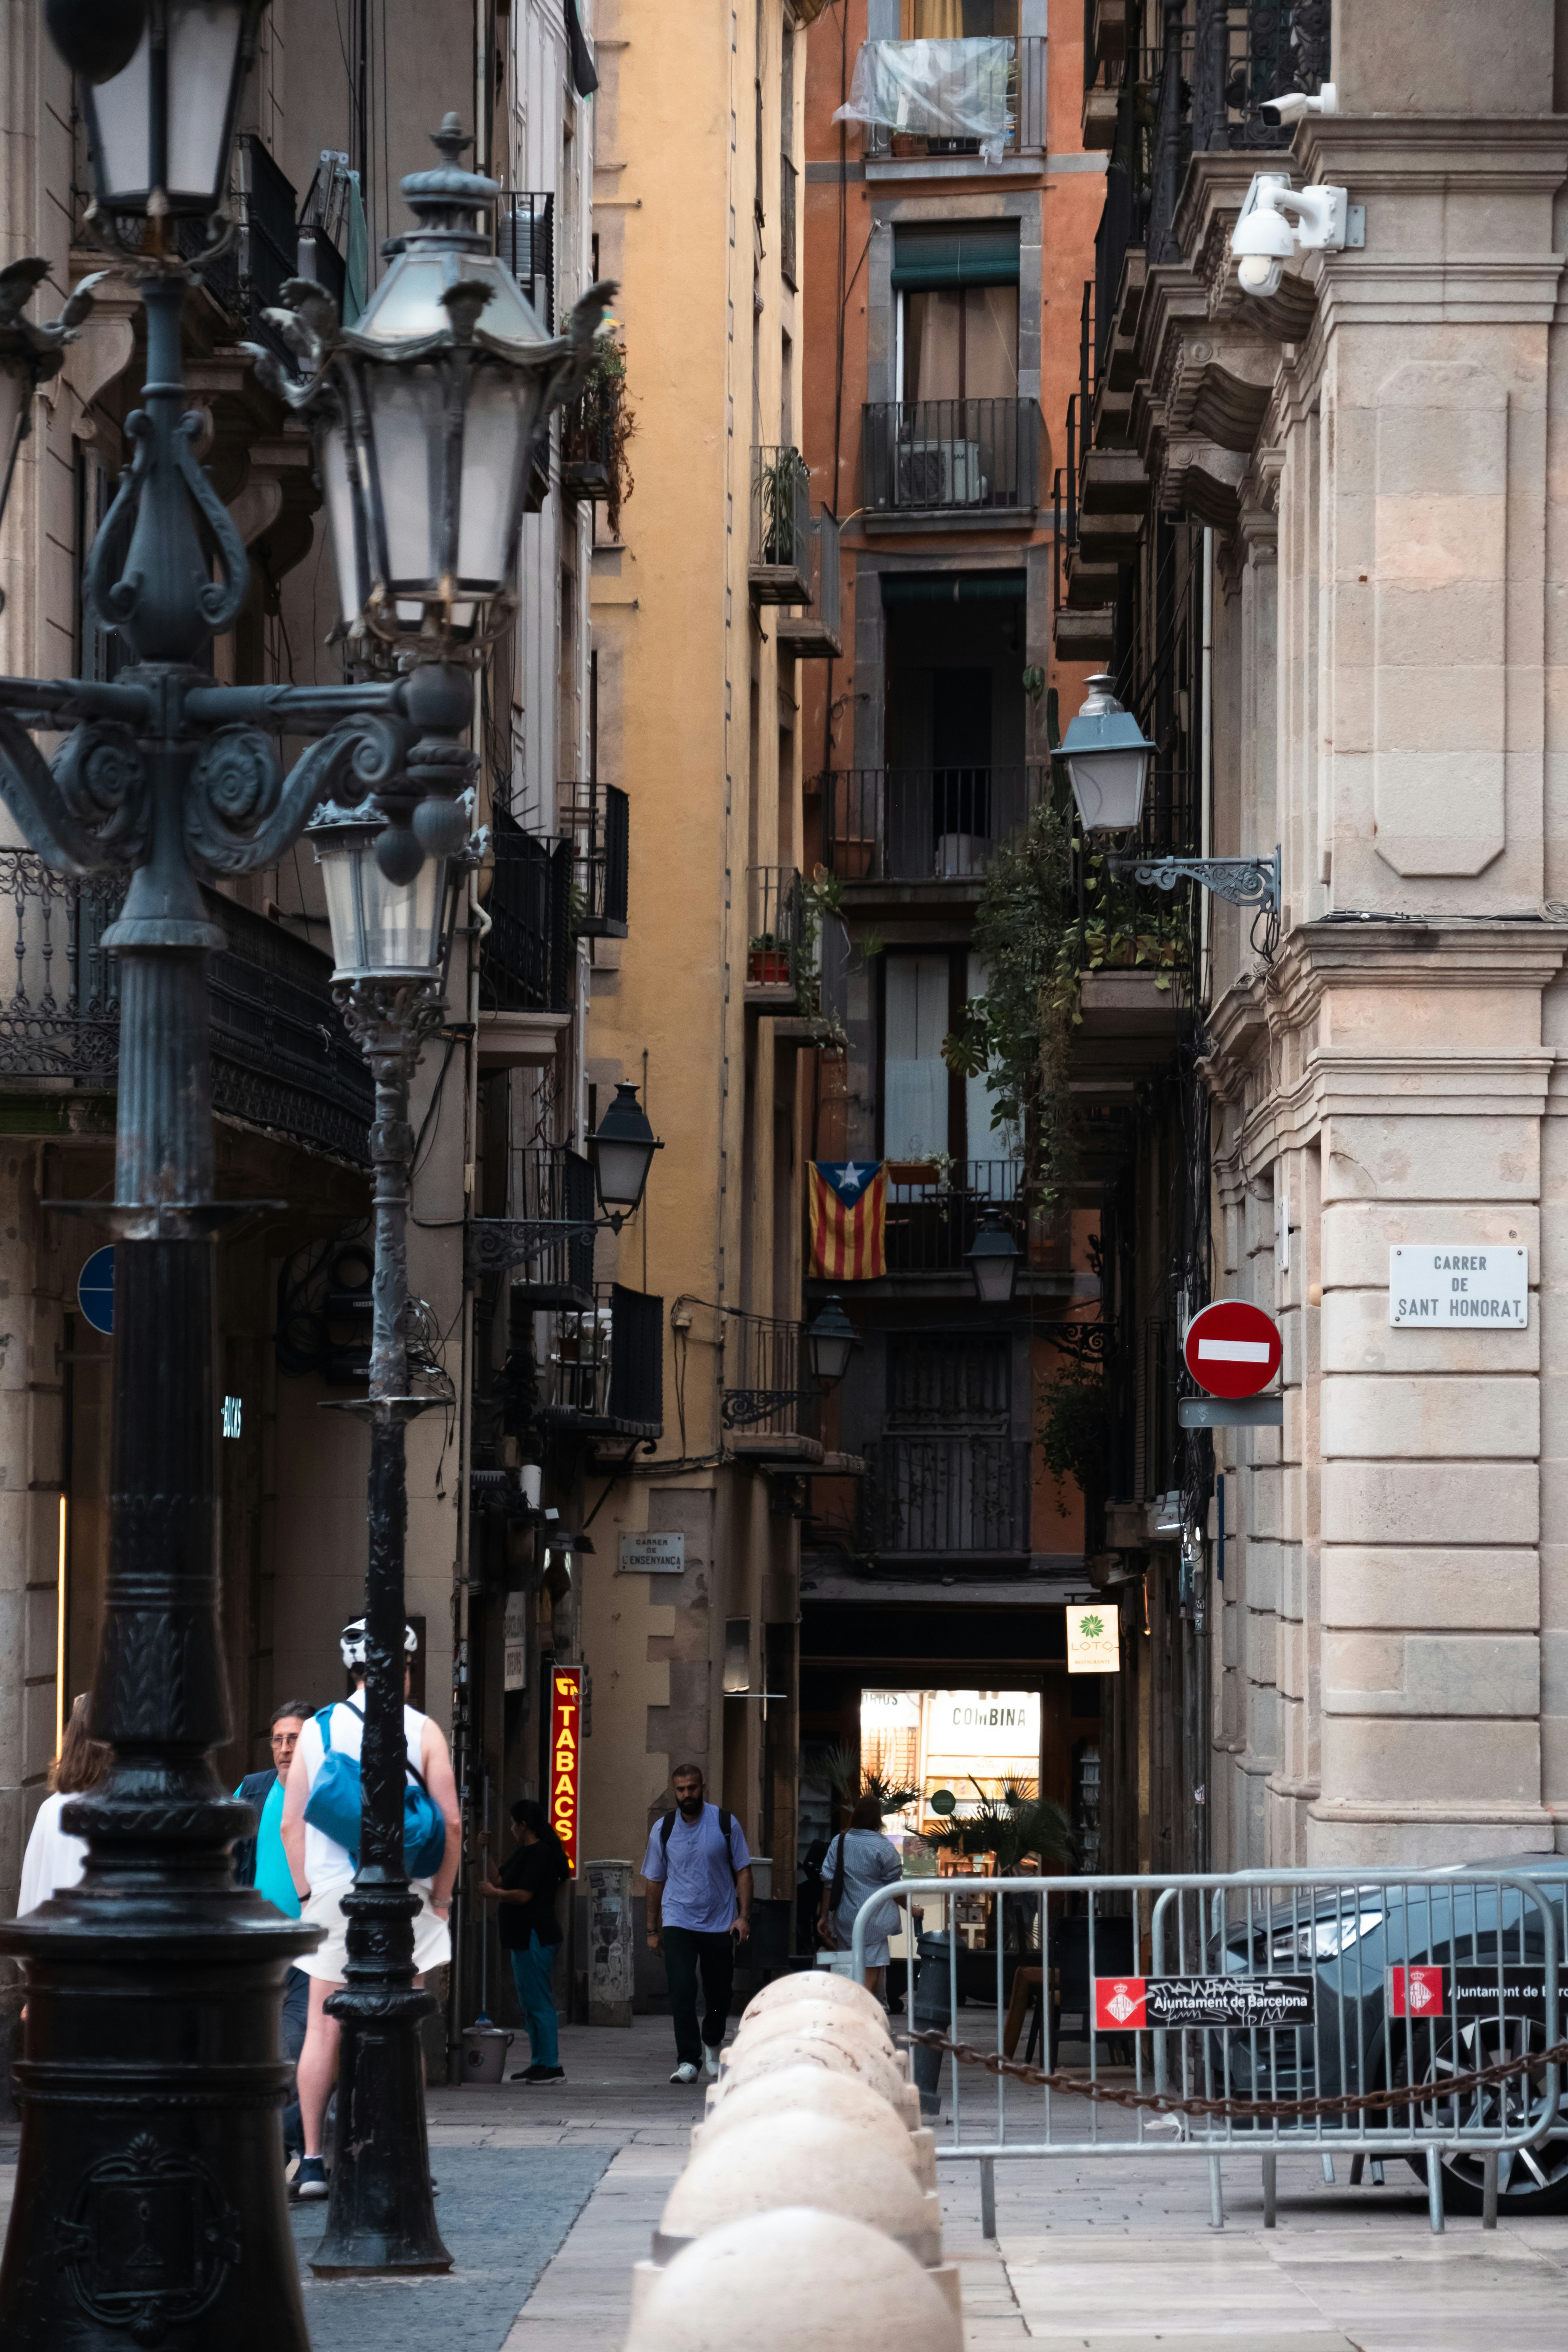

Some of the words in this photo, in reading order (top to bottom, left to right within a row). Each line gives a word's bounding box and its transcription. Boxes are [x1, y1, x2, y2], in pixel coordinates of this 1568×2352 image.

[1434, 1256, 1487, 1271] CARRER
[1452, 1278, 1468, 1292] DE
[1398, 1298, 1439, 1316] SANT
[1450, 1299, 1521, 1317] HONORAT
[953, 1707, 1026, 1726] COMBINA
[554, 1706, 576, 1841] TABACS
[1523, 1985, 1539, 1997] de
[1154, 1996, 1228, 2011] Ajuntament
[1230, 1995, 1245, 2008] de
[1248, 1994, 1308, 2007] Barcelona
